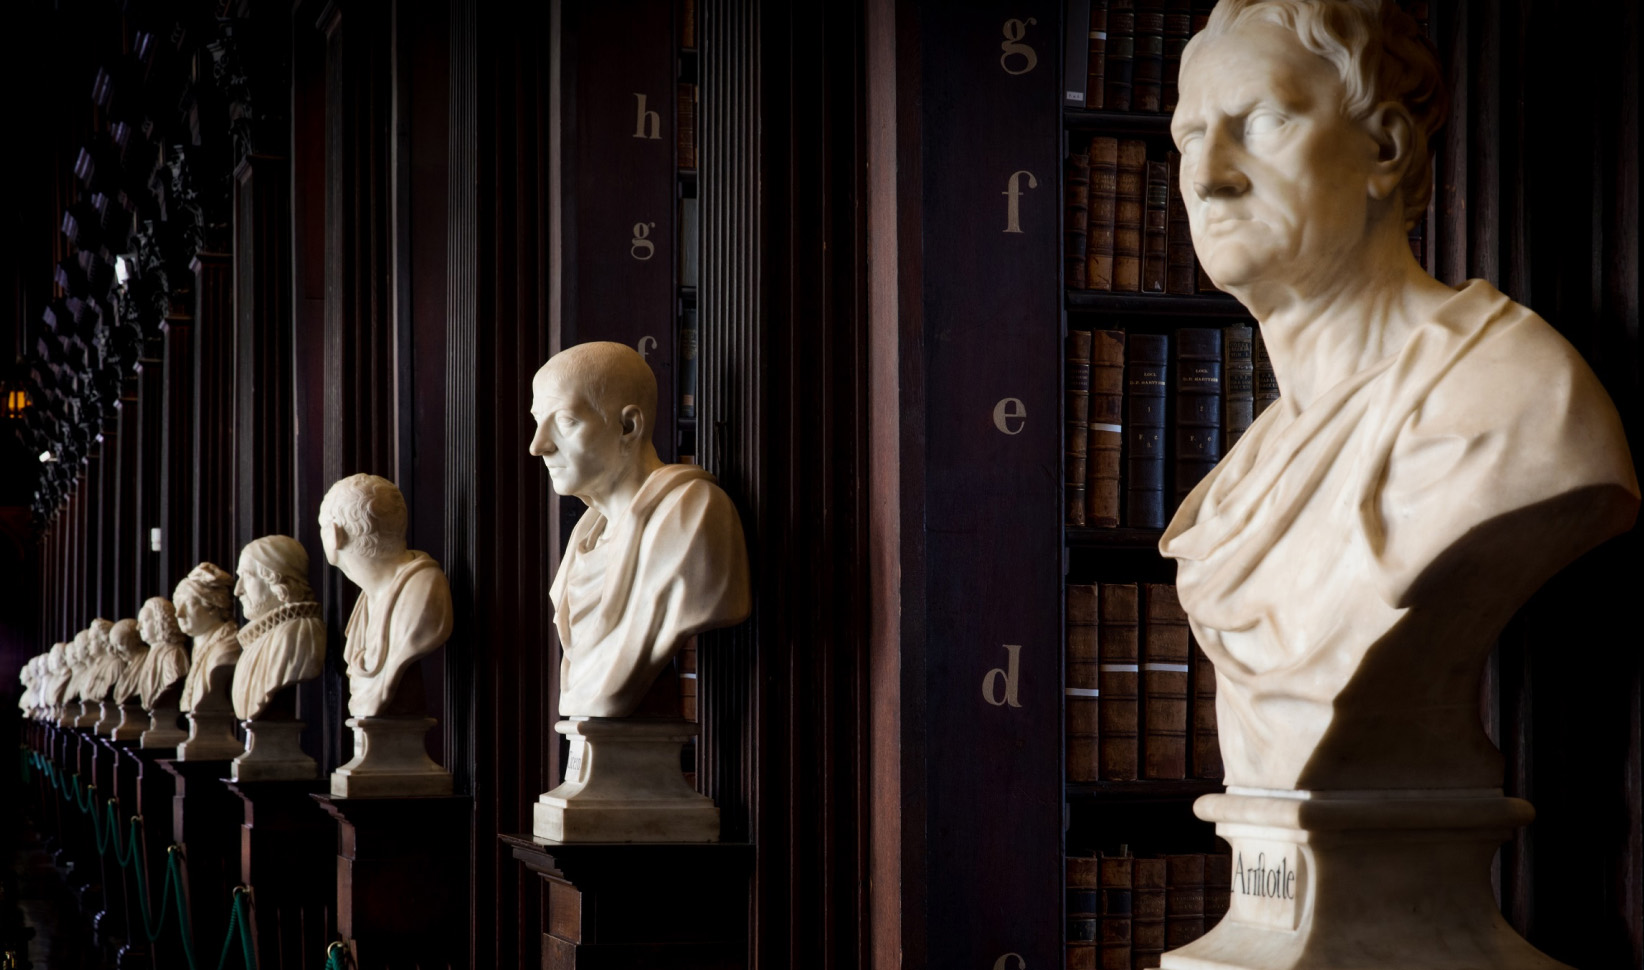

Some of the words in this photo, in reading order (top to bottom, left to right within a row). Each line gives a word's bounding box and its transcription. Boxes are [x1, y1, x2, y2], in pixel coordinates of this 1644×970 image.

[1001, 17, 1038, 76] g
[632, 93, 662, 140] h
[1002, 170, 1038, 233] f
[630, 222, 656, 261] g
[993, 398, 1028, 437] e
[981, 644, 1023, 708] d
